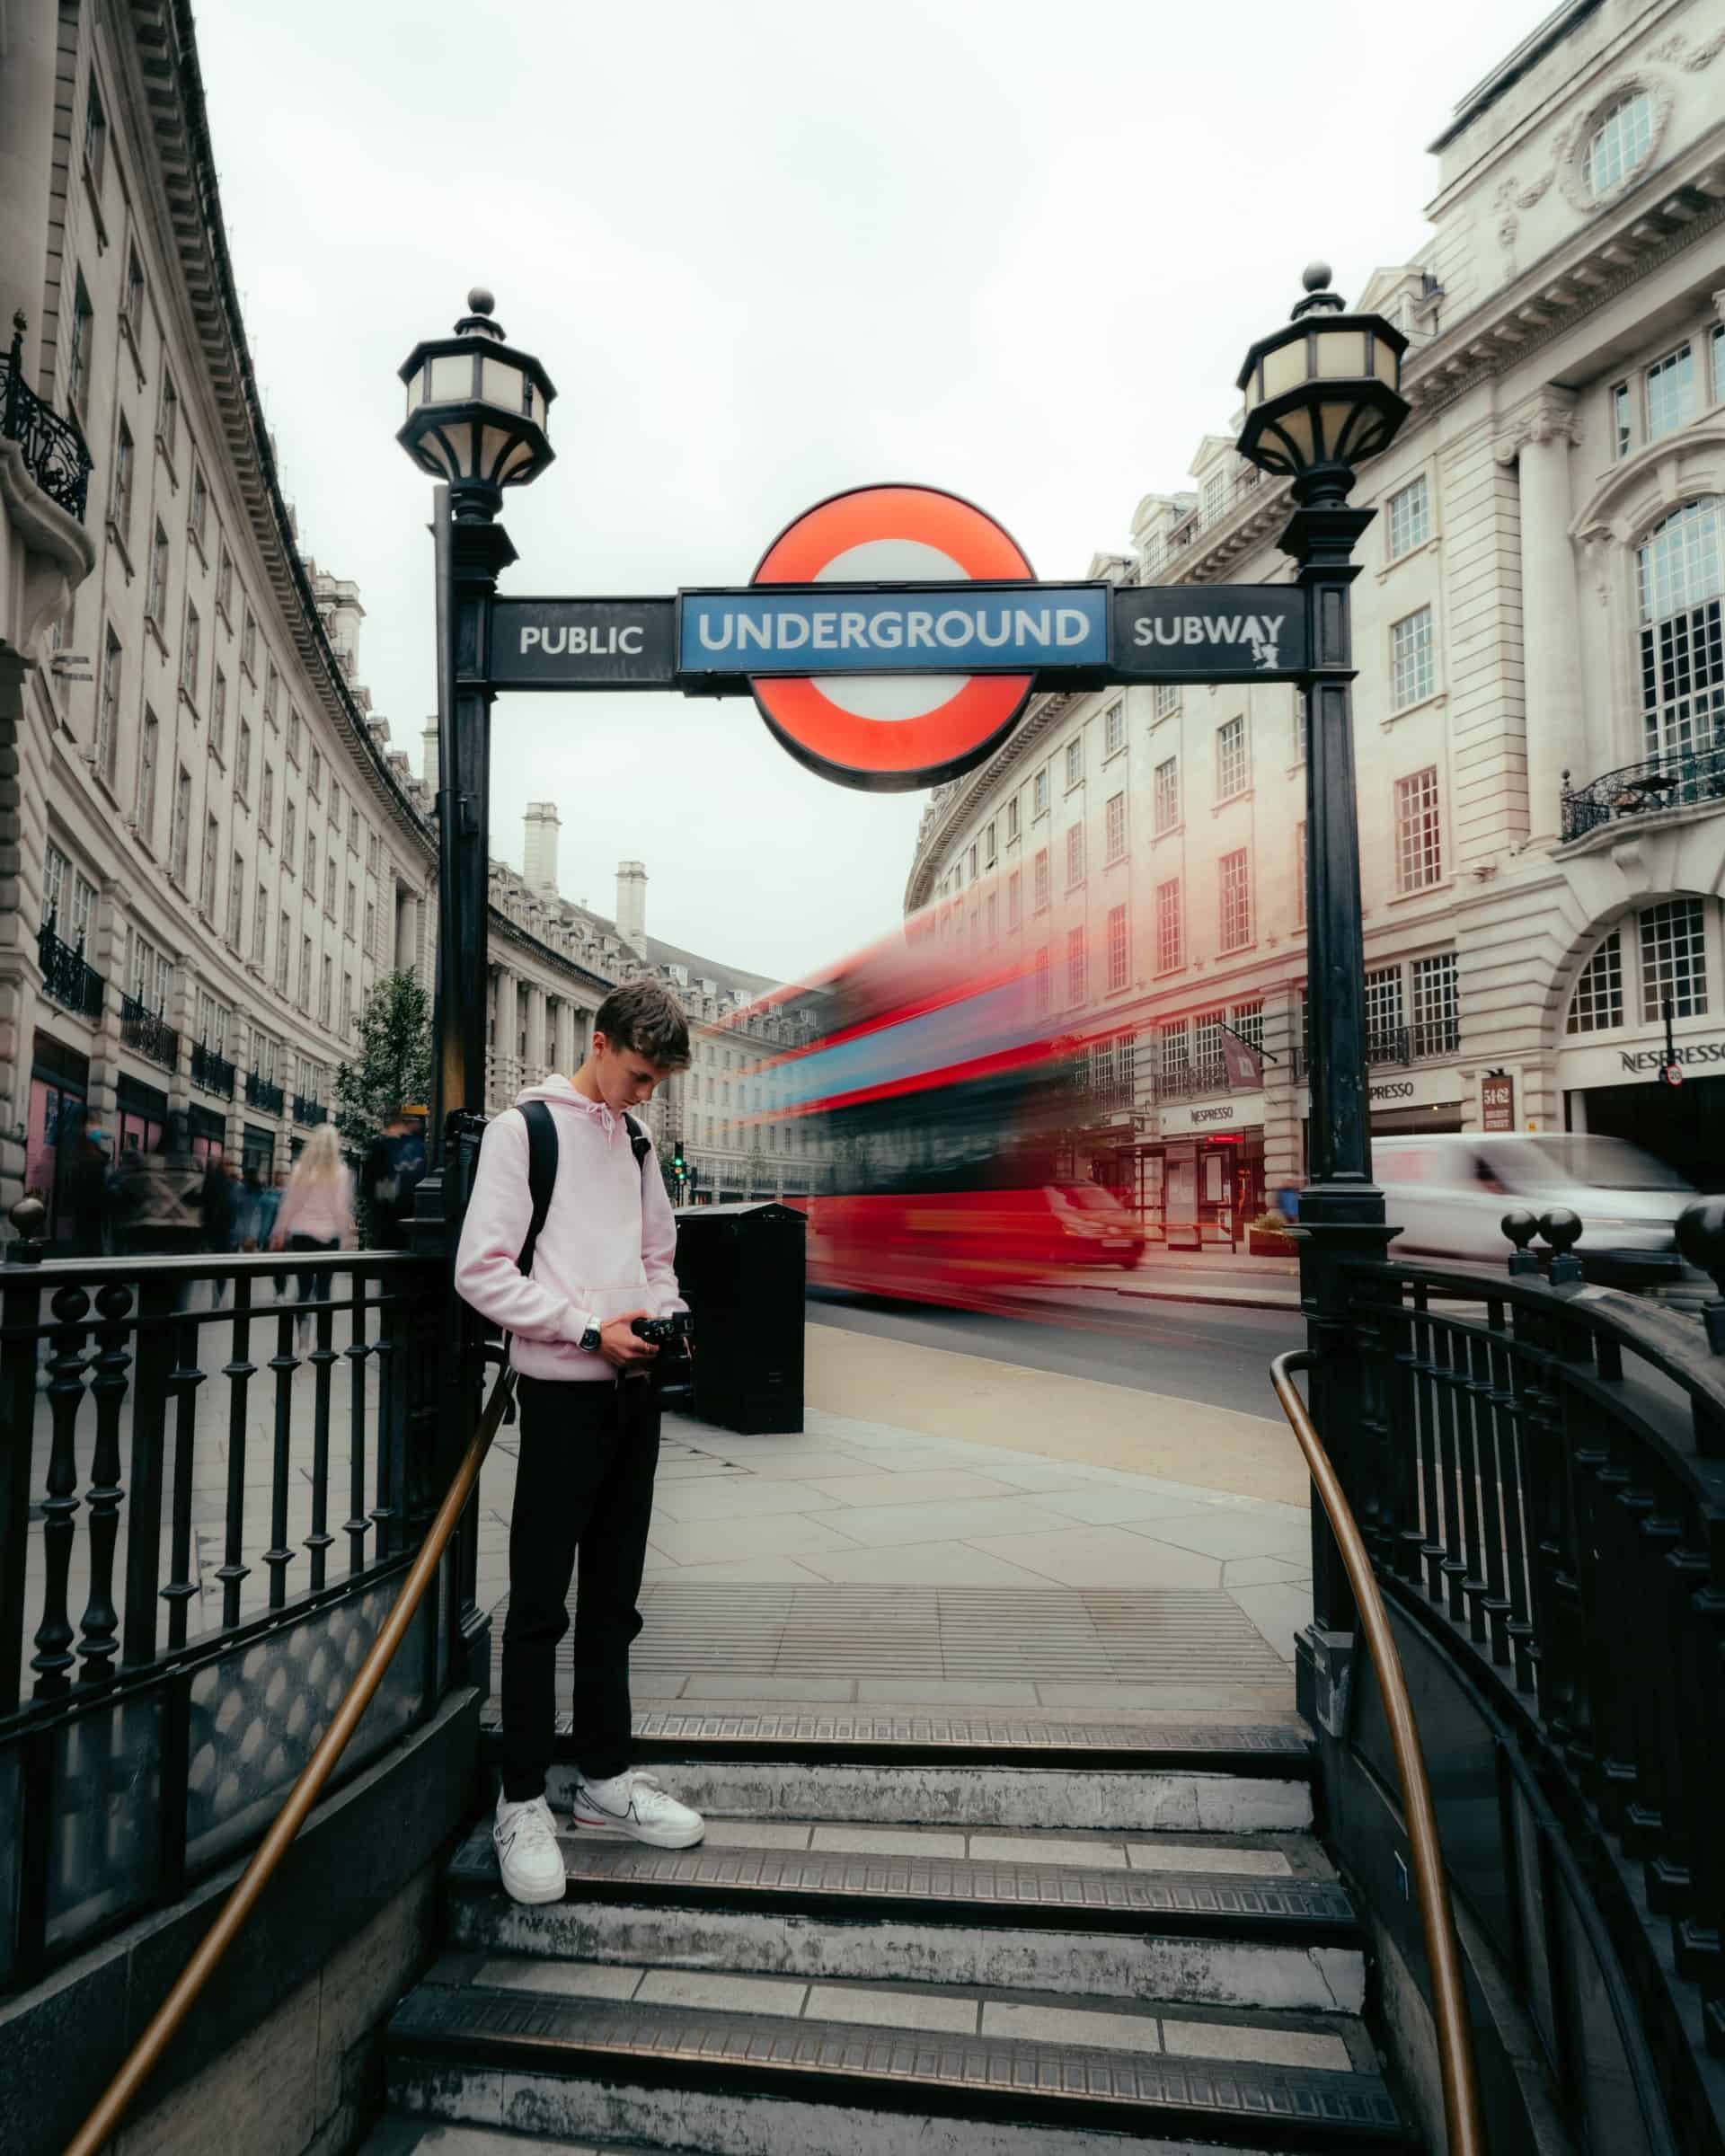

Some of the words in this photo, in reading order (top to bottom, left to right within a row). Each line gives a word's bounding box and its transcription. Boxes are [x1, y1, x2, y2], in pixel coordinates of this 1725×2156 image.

[520, 626, 644, 654] PUBLIC
[699, 609, 1090, 650] UNDERGROUND
[1134, 615, 1286, 646] SUBWAY
[1369, 1082, 1414, 1100] PRESSO
[1190, 1106, 1234, 1125] NESPRESSO
